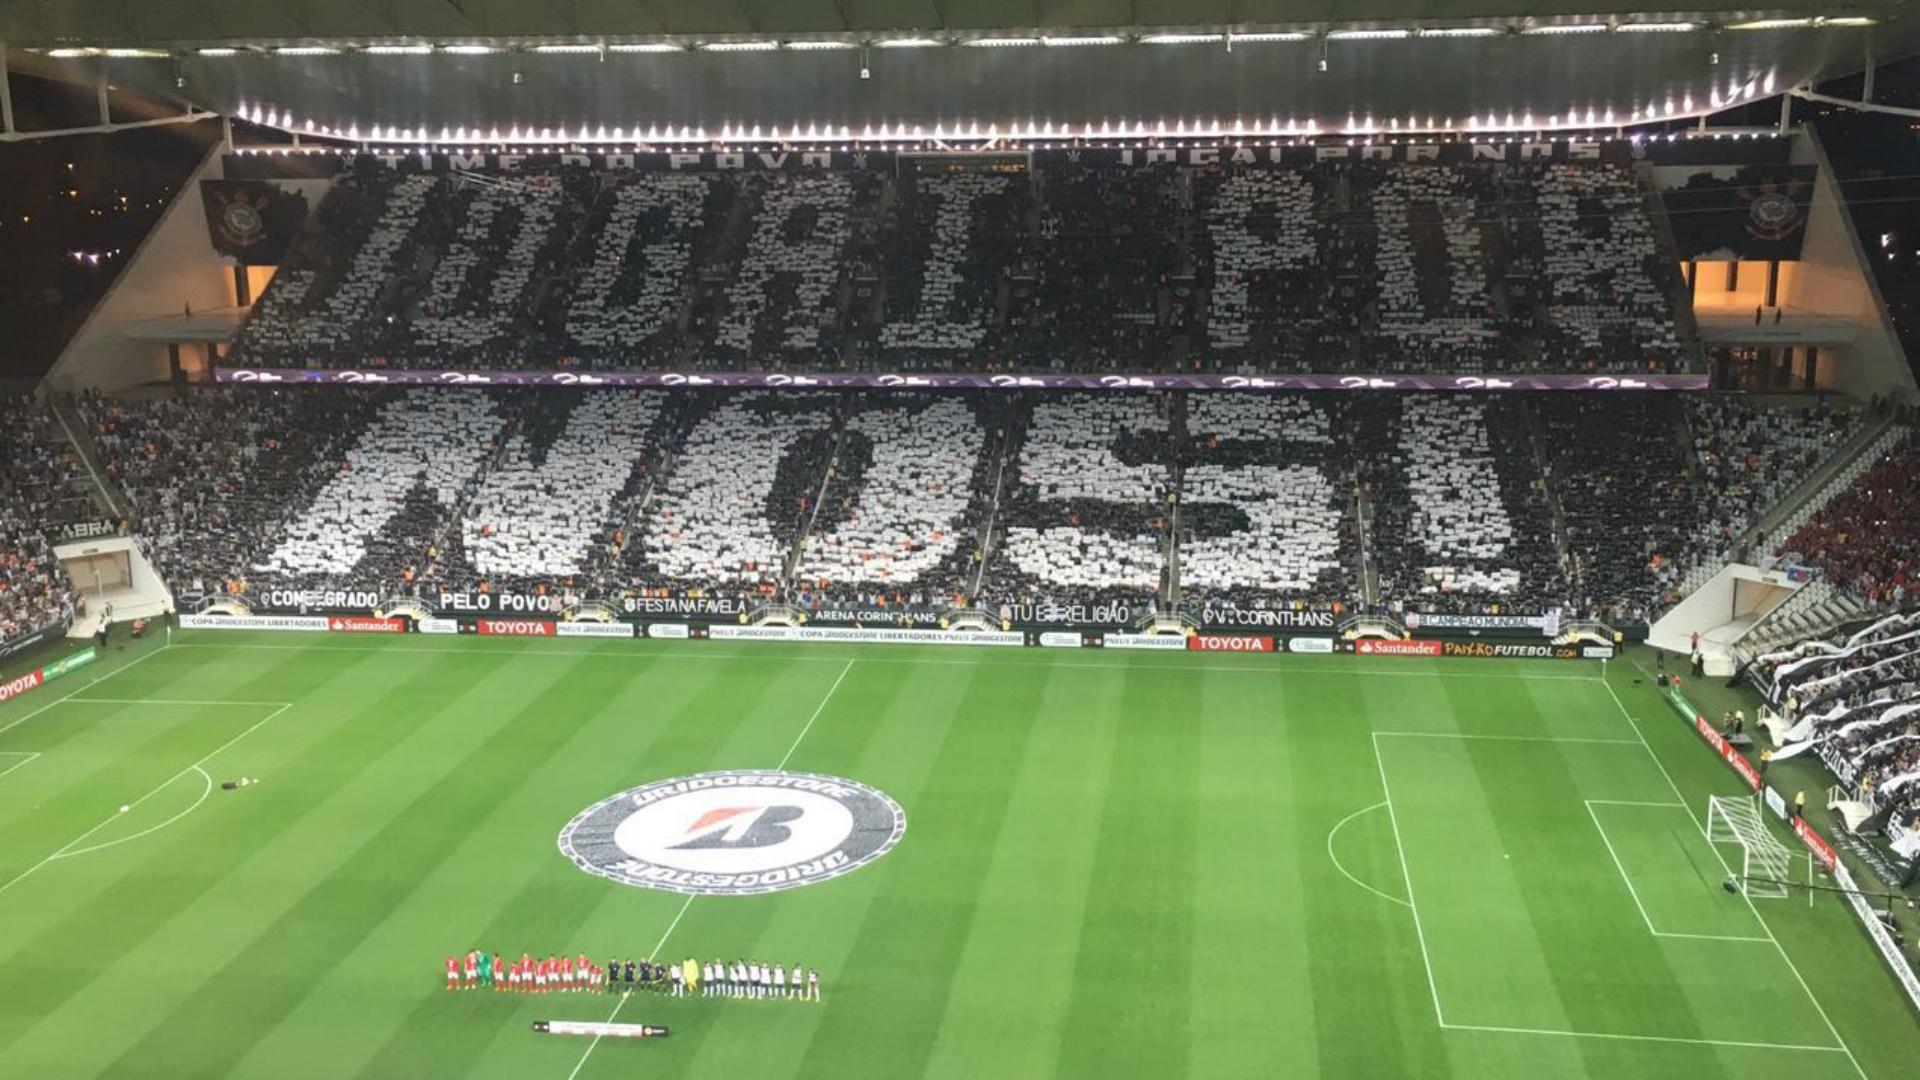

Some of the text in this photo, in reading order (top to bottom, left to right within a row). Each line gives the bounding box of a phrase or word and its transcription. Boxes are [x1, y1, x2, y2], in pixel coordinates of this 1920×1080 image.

[271, 590, 378, 608] CONGRADO
[440, 593, 550, 611] PELO POVO
[815, 610, 855, 620] ARENA
[1238, 610, 1333, 626] CORINTHIANS
[267, 618, 326, 628] LIBERTADORES
[345, 618, 399, 631] Santander
[485, 621, 546, 633] TOYOTA
[1199, 636, 1263, 650] TOYOTA
[1374, 641, 1436, 654] Santander
[0, 674, 38, 700] OYOTA
